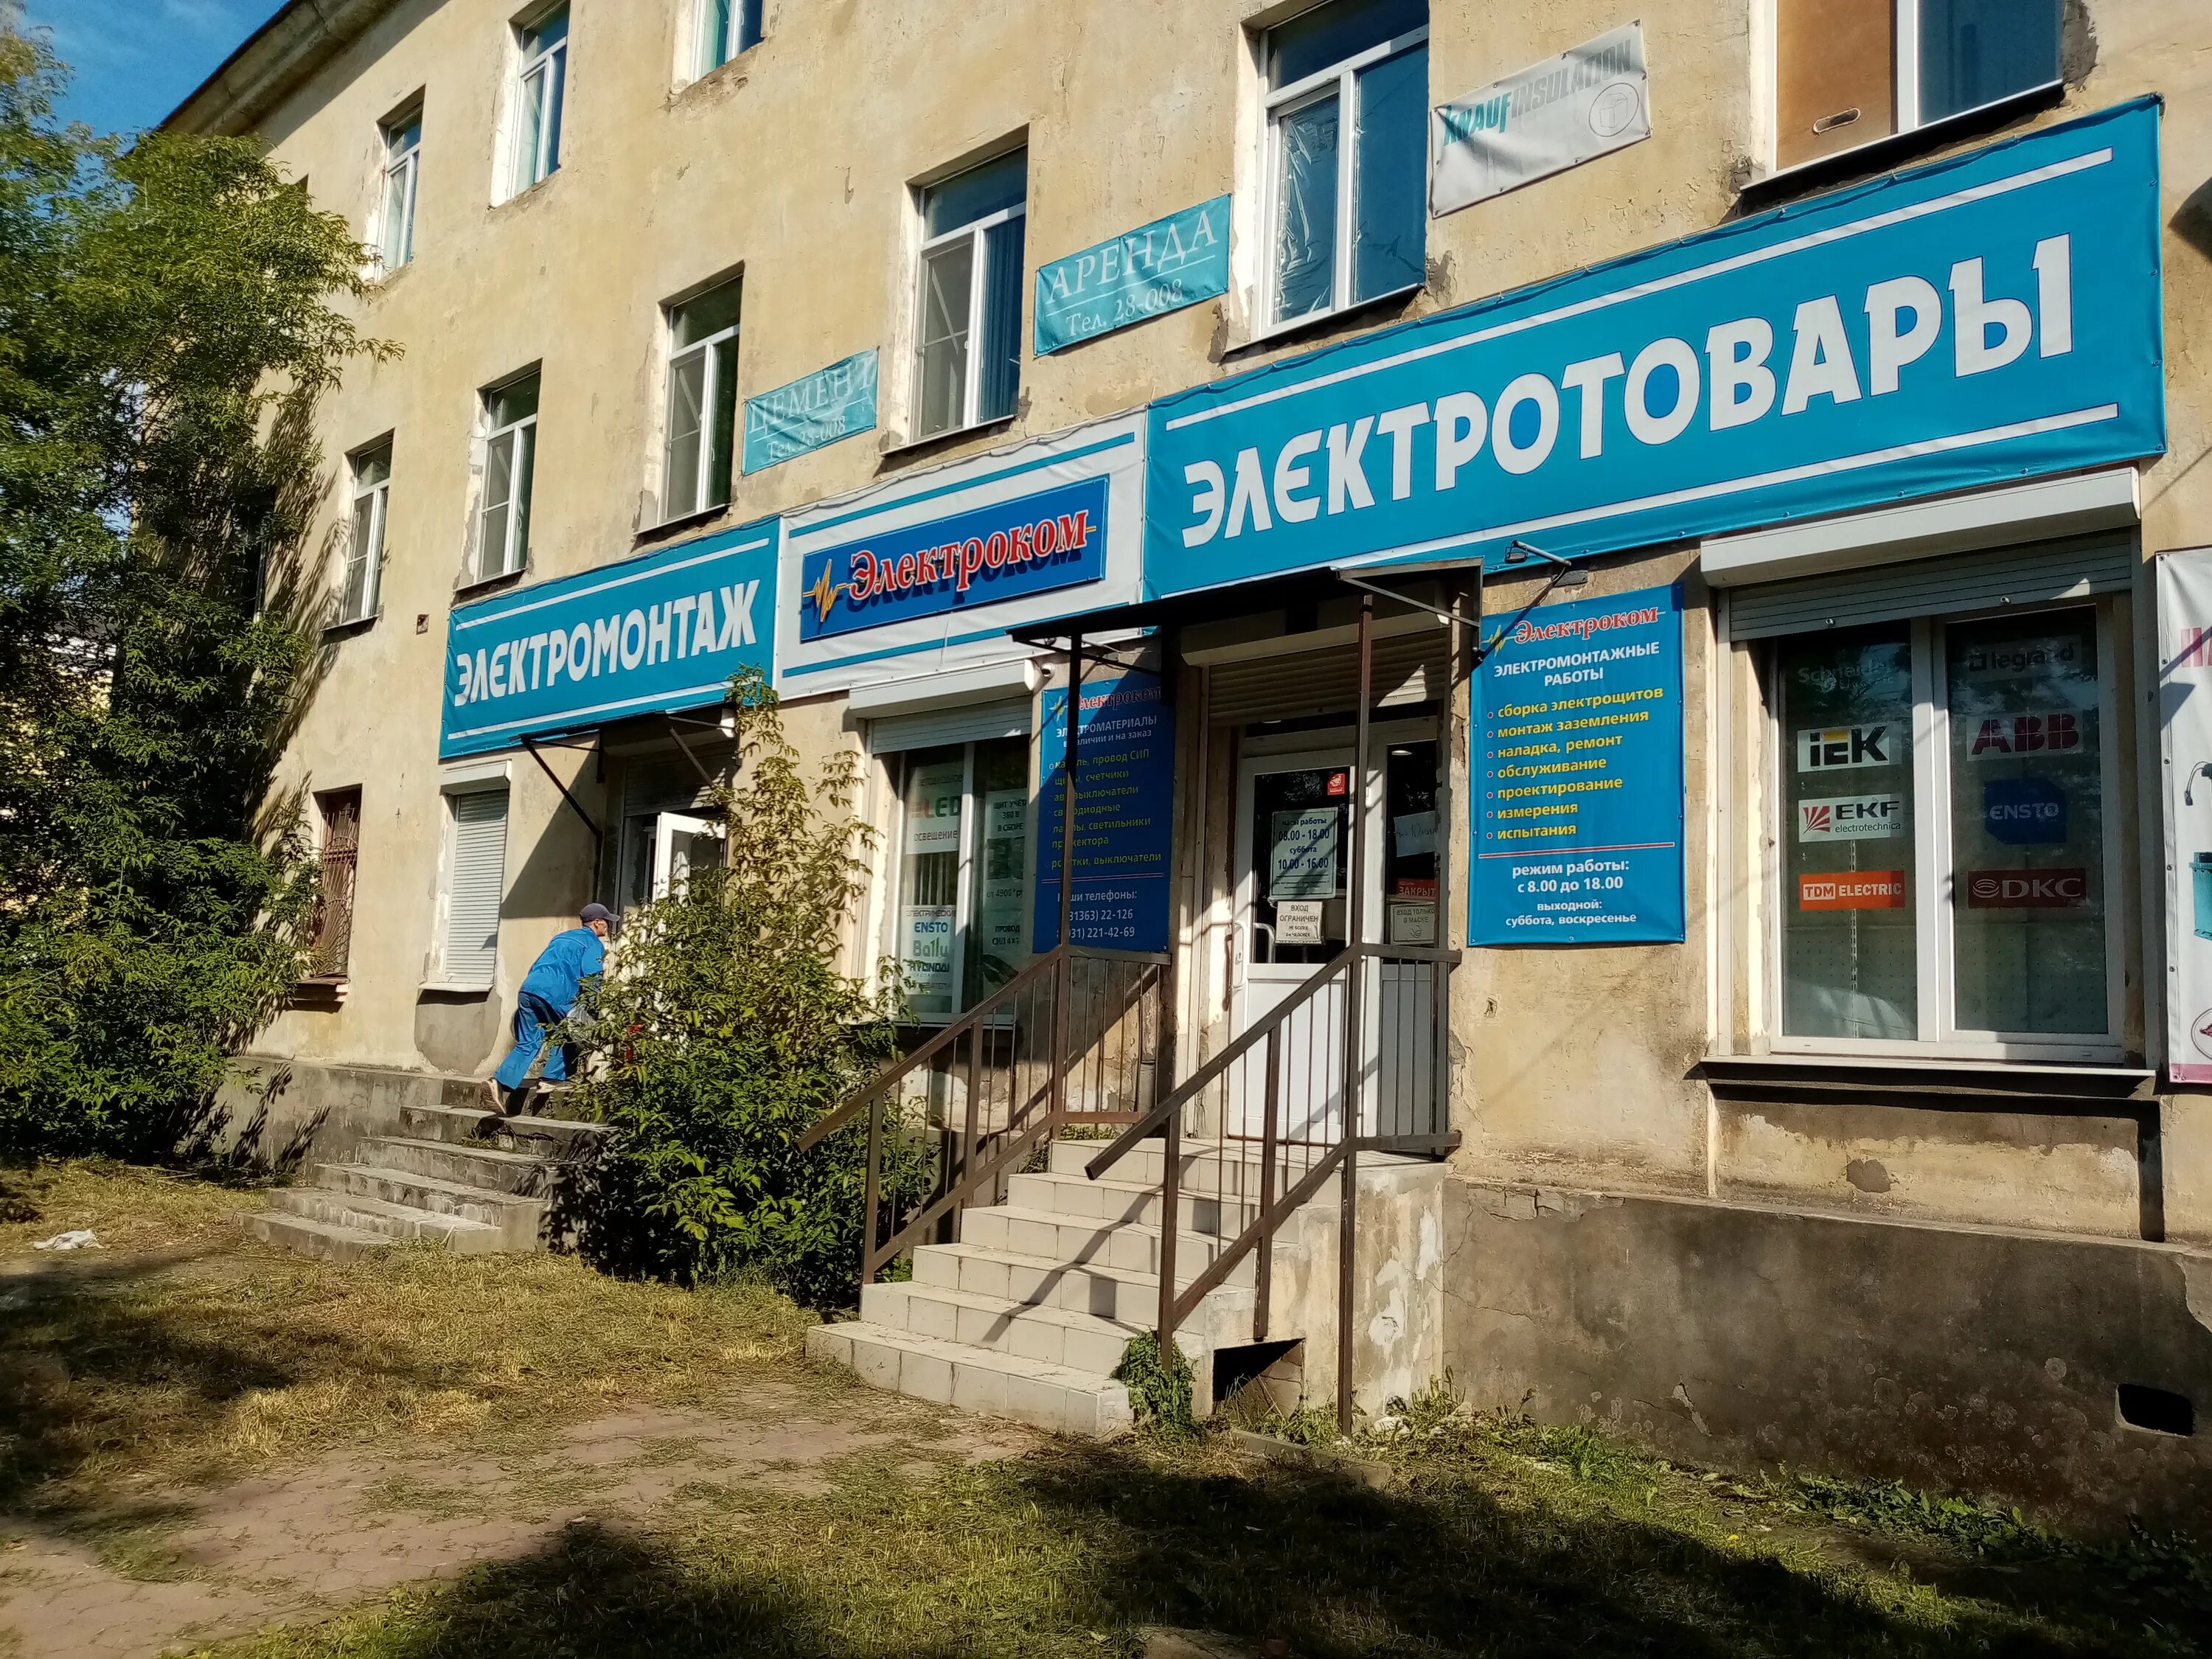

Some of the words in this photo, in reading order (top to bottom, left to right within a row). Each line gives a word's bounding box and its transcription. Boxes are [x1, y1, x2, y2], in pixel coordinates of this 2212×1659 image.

[1443, 91, 1512, 146] KNAUF
[1512, 39, 1631, 118] INSULATION
[1046, 211, 1217, 305] АРЕНДА
[1066, 313, 1107, 337] Тел.
[1114, 279, 1182, 321] 28-008
[749, 355, 873, 435] ЦЕМЕНТ
[1182, 234, 2073, 549] ЭЛЕКТРОТОВАРЫ
[847, 509, 1089, 601] Электроком
[1514, 606, 1659, 644] Электроком
[454, 579, 760, 706] ЭЛЕКТРОМОНТАЖ
[1494, 641, 1660, 678] ЭЛЕКТРОМОНТАЖНЫЕ
[1544, 667, 1604, 687] РАБОТЫ
[1498, 701, 1548, 720] сборка
[1551, 686, 1664, 712] электрощитов
[1056, 715, 1157, 739] ЭЛТРОМАТЕРИАЛЫ
[1498, 722, 1553, 738] монтаж
[1557, 710, 1649, 732] заземления
[1971, 713, 2079, 755] ABB
[1077, 735, 1106, 746] аличии
[1116, 732, 1126, 741] на
[1128, 729, 1152, 740] заказ
[1498, 741, 1561, 759] наладка,
[1566, 735, 1623, 754] ремонт
[1055, 757, 1090, 769] каль,
[1093, 753, 1128, 766] провод
[1130, 749, 1150, 760] СИП
[1498, 756, 1607, 780] обслуживание
[1085, 770, 1130, 782] счетчики
[1054, 785, 1139, 802] аввыключатели
[1498, 777, 1624, 801] проектирование
[1054, 803, 1121, 817] сводиодные
[1498, 803, 1579, 821] измерения
[1835, 800, 1901, 821] EKF
[1989, 801, 2059, 820] ENSTO
[1088, 818, 1152, 831] светильники
[1300, 817, 1327, 827] работы
[1834, 820, 1902, 833] electrotechnica
[1278, 830, 1300, 841] 08.00
[1308, 828, 1329, 840] 18.00
[1498, 824, 1577, 841] испытания
[1093, 852, 1162, 866] выключатели
[1290, 845, 1317, 855] суббота
[1278, 858, 1299, 870] 10.00
[1307, 858, 1329, 869] 16.00
[1512, 862, 1563, 880] режим
[1566, 858, 1630, 879] работы:
[1517, 883, 1524, 893] с
[1528, 880, 1557, 893] 8.00
[1559, 881, 1579, 894] до
[1583, 876, 1624, 891] 18.00
[1804, 884, 1834, 900] TDM
[1838, 880, 1902, 897] ELECTRIC
[2003, 877, 2082, 899] DKC
[1085, 890, 1138, 902] телефоны:
[1537, 899, 1603, 912] выходной:
[1101, 908, 1134, 921] 22-126
[1290, 905, 1309, 913] ВХОД
[1506, 913, 1555, 927] суббота,
[1558, 911, 1637, 925] воскресенье
[914, 922, 948, 933] ENSTO
[1088, 926, 1135, 938] 221-42-69
[913, 937, 949, 957] Ballu
